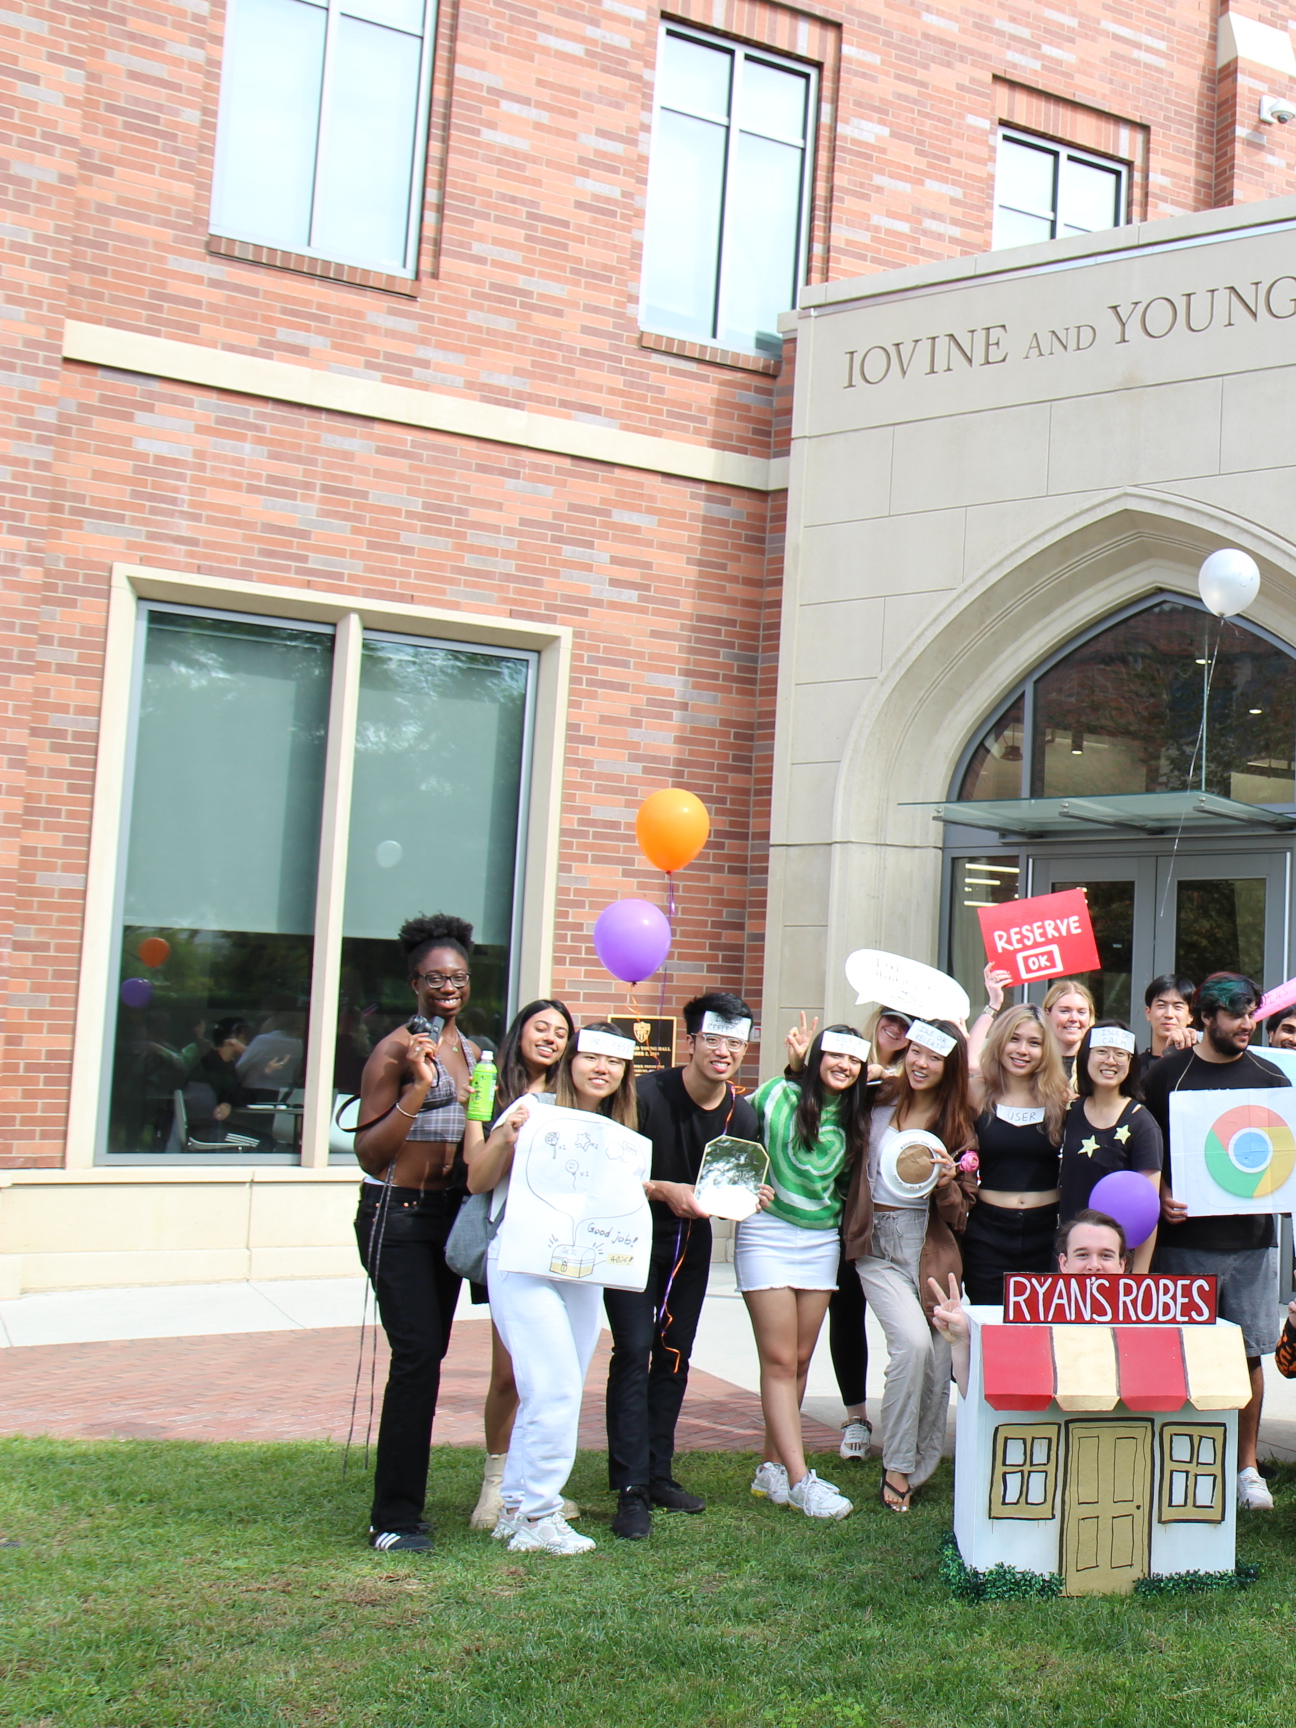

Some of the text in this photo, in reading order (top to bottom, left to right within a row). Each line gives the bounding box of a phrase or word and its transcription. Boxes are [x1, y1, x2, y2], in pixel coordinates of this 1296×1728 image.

[842, 323, 1009, 389] IOVINE
[1023, 322, 1097, 360] AND
[993, 915, 1082, 953] RESERVE
[1028, 954, 1051, 970] OK
[915, 1033, 945, 1052] RELEASE
[1102, 1037, 1127, 1048] CALM
[1007, 1111, 1037, 1122] USER
[587, 1222, 639, 1248] Good job!
[1008, 1276, 1210, 1322] RYAN'S ROBES
